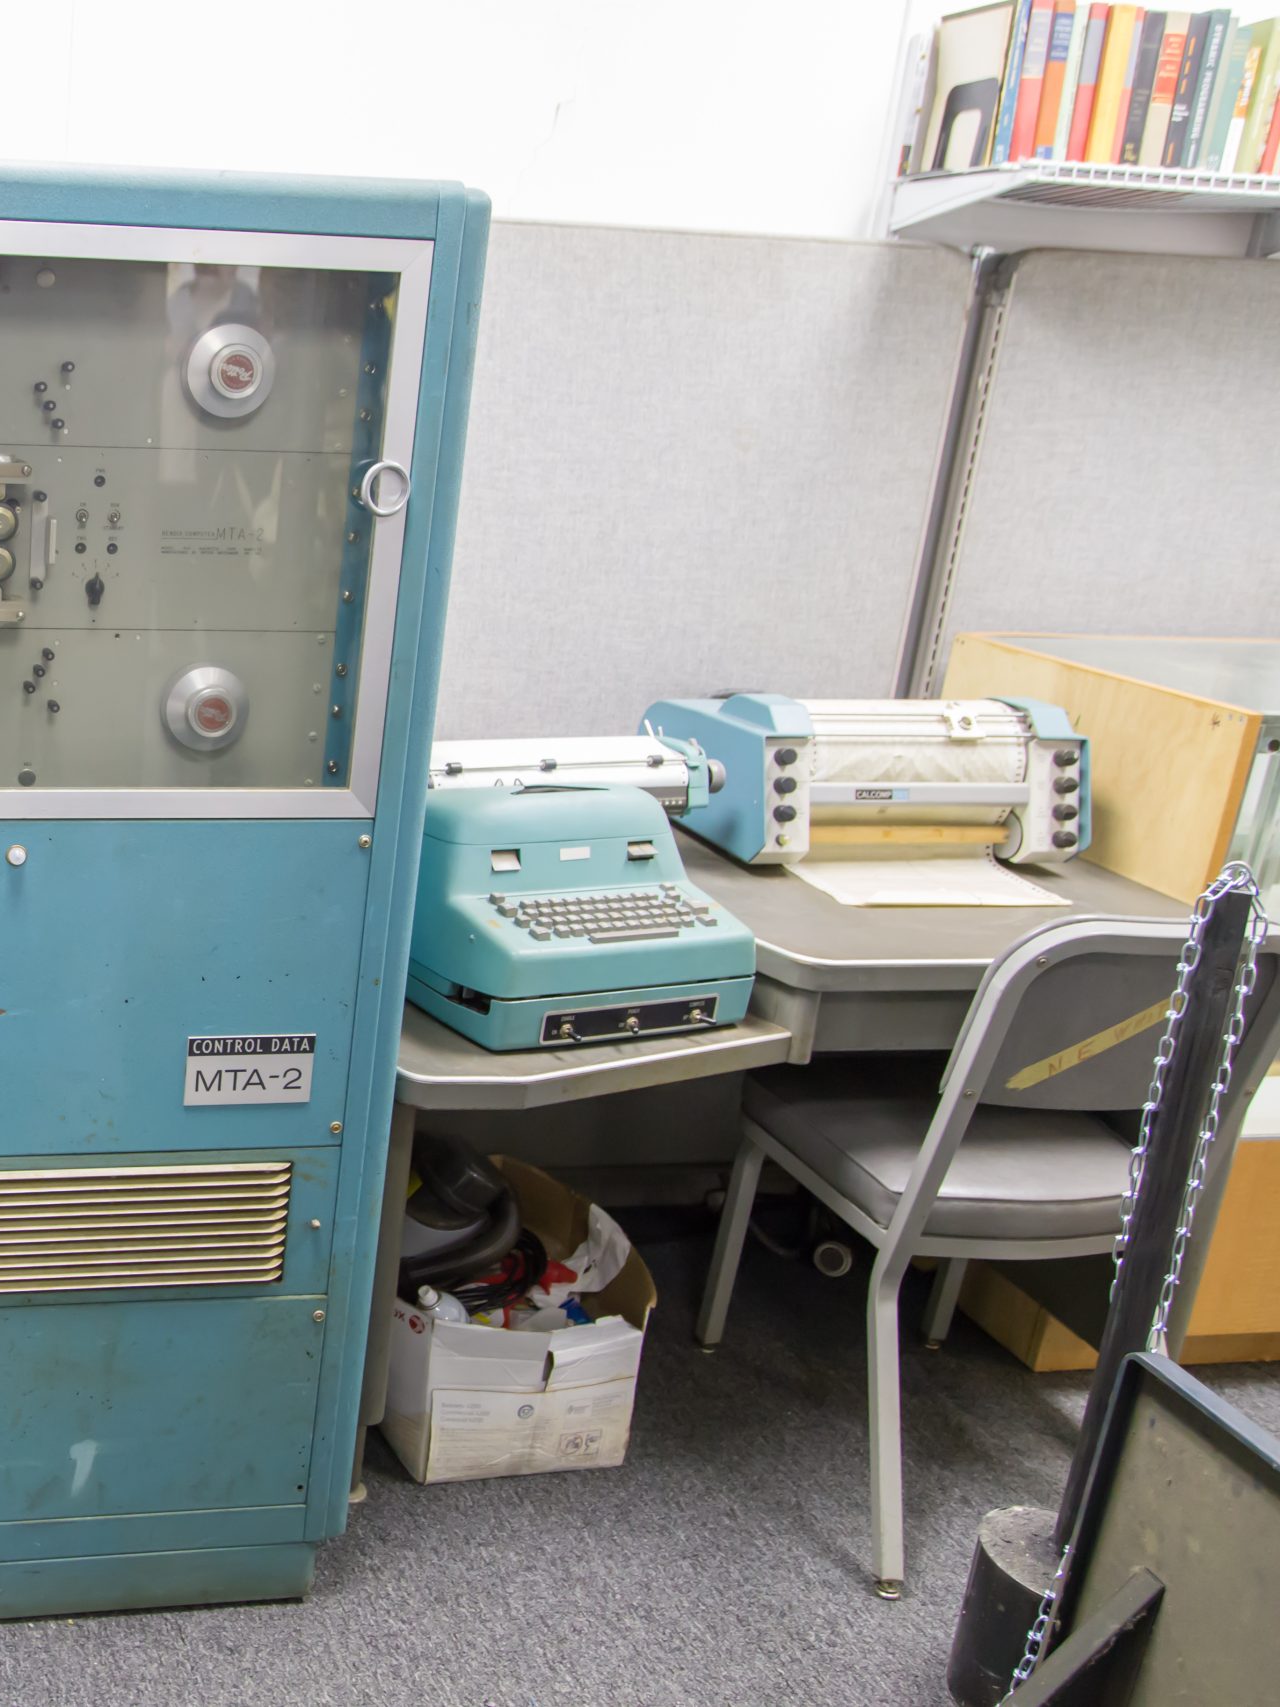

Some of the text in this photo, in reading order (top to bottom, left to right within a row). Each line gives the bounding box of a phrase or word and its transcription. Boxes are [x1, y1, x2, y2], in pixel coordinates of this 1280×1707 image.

[216, 527, 265, 541] MTA-2
[192, 1038, 310, 1054] CONTROL DATA
[194, 1068, 302, 1092] MTA-2
